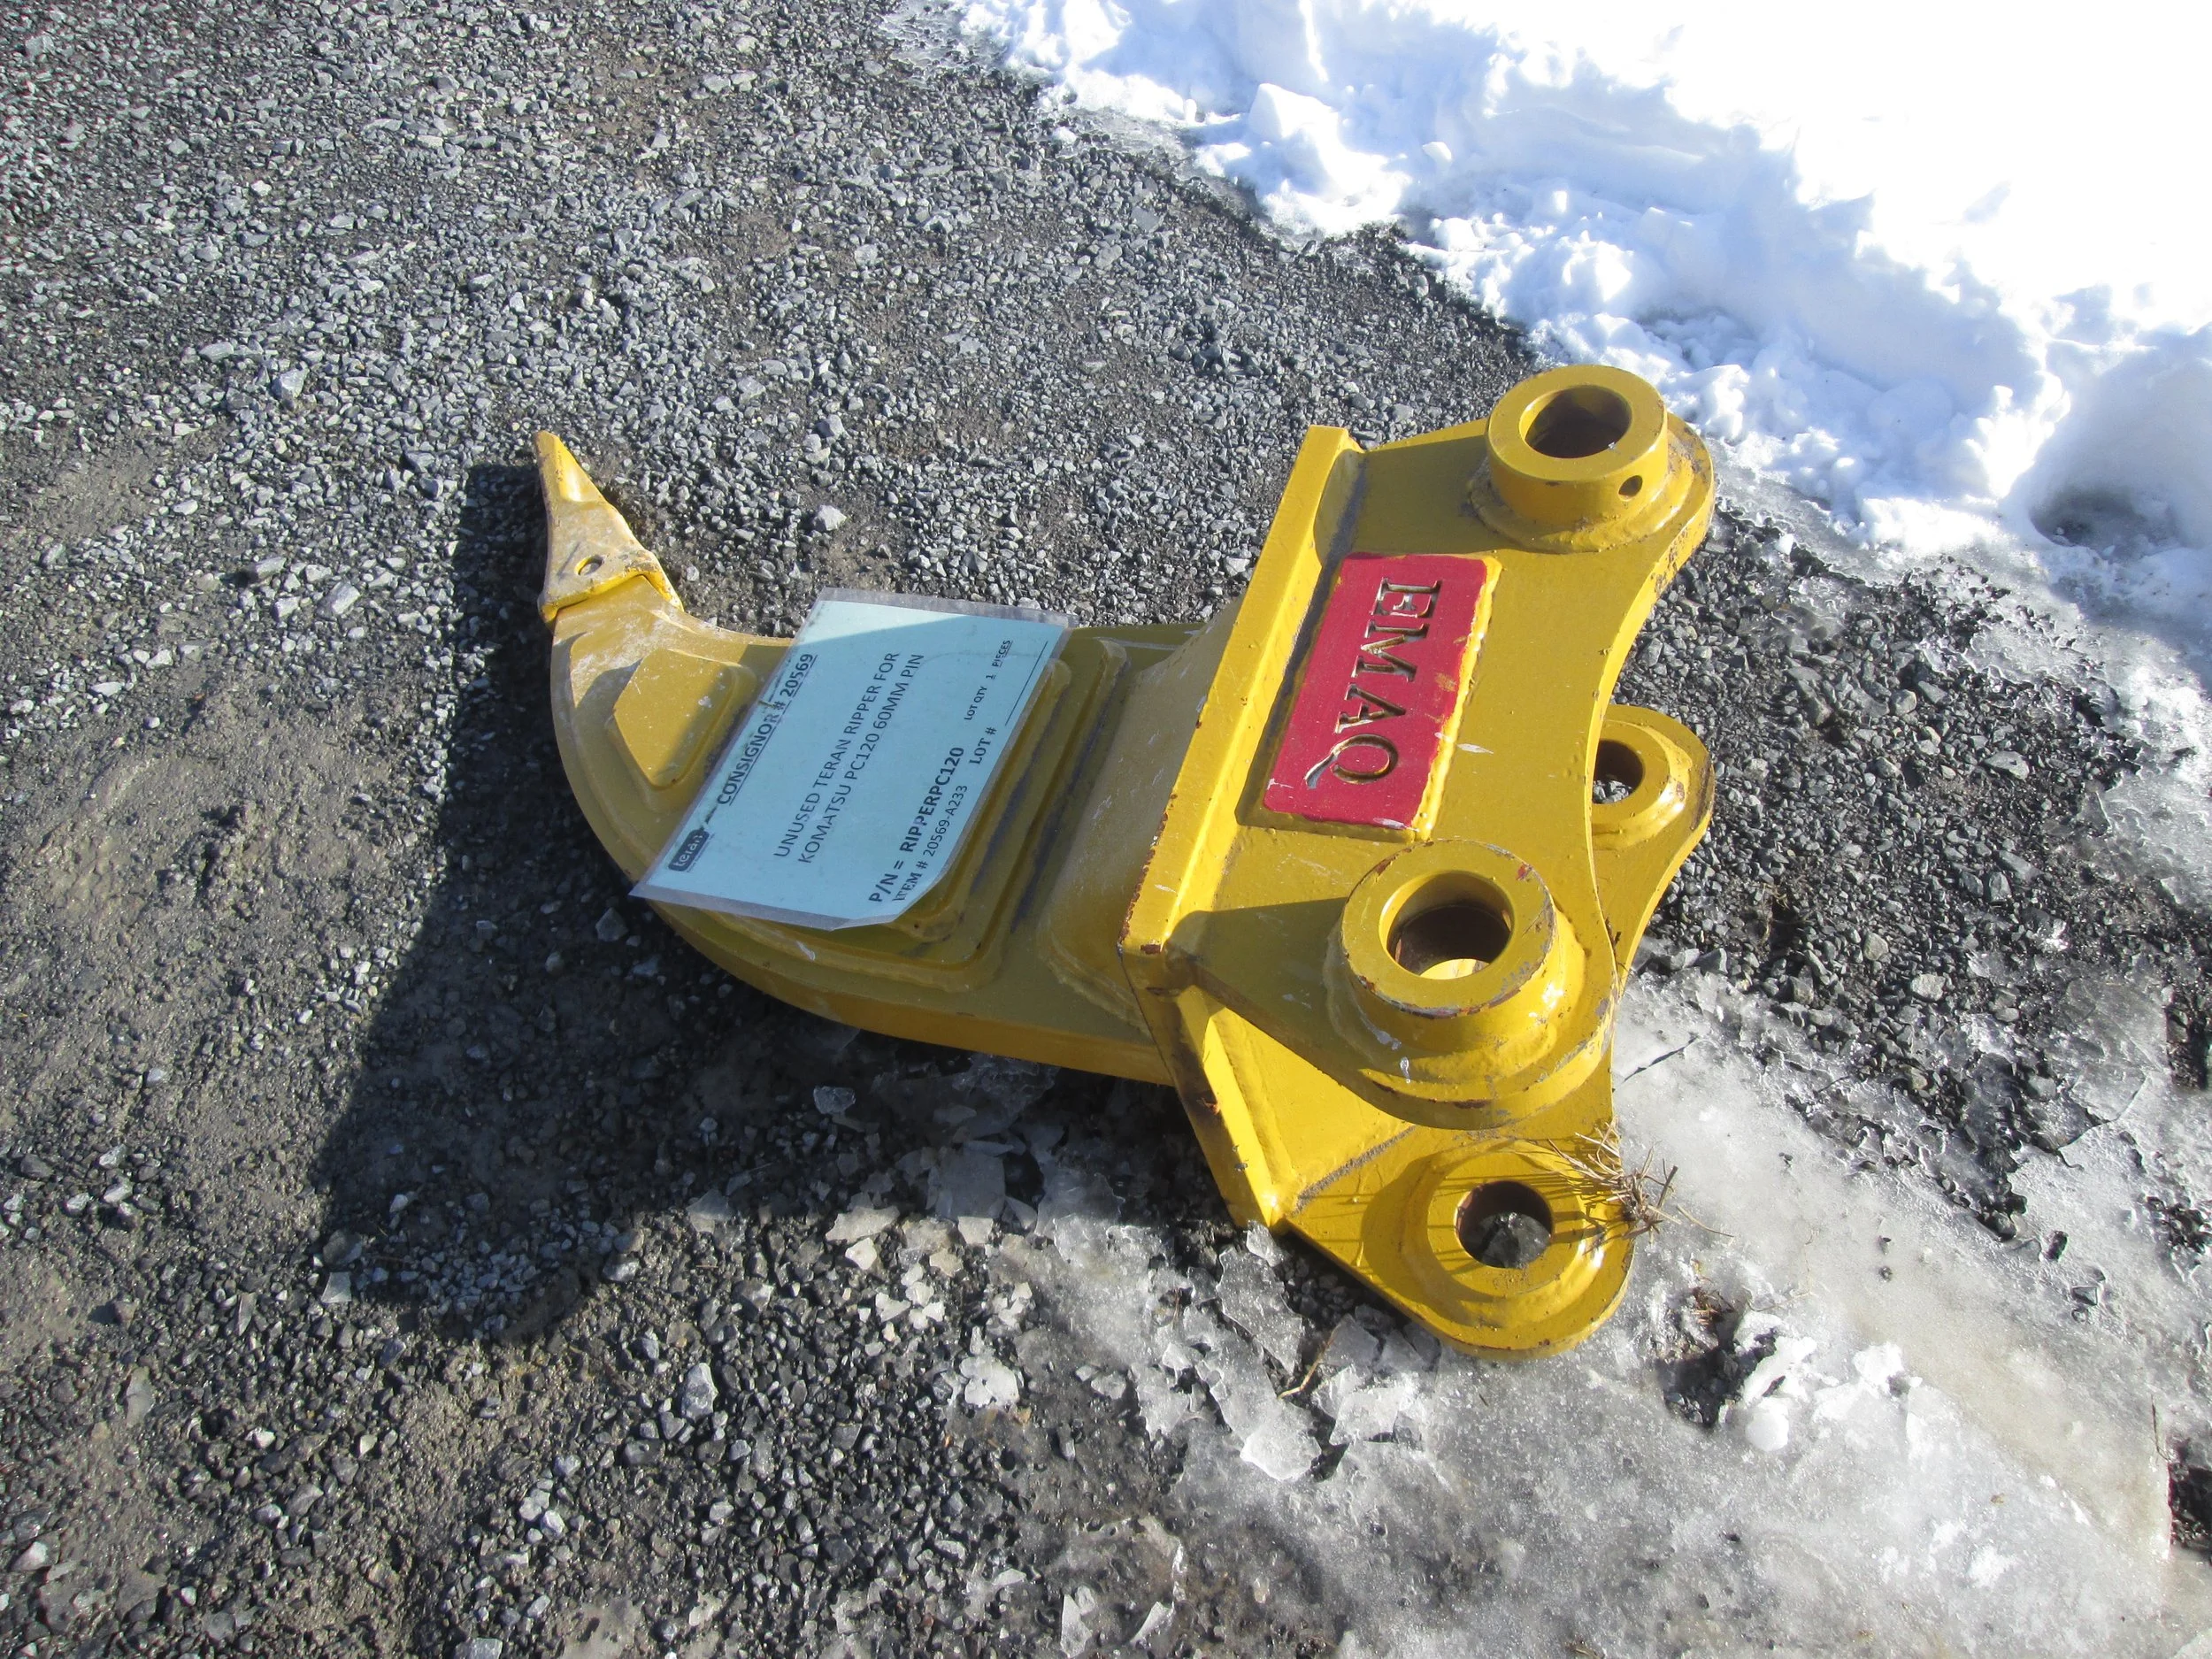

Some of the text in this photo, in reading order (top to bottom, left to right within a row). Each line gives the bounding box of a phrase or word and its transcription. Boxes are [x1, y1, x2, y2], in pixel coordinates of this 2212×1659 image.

[717, 653, 814, 805] CONSIGNOR # 20569
[772, 652, 901, 857] UNUSED TERAN RIPPER FOR
[964, 704, 978, 721] LOT
[973, 686, 987, 704] QTY
[991, 640, 1012, 668] PIECES
[969, 726, 997, 765] LOT #
[1302, 577, 1443, 789] EMAQ
[797, 654, 925, 864] KOMATSU PC120 60MM PIN
[868, 746, 965, 902] P/N = RIPPERPC120
[891, 784, 968, 902] ITEM # 20569-A233
